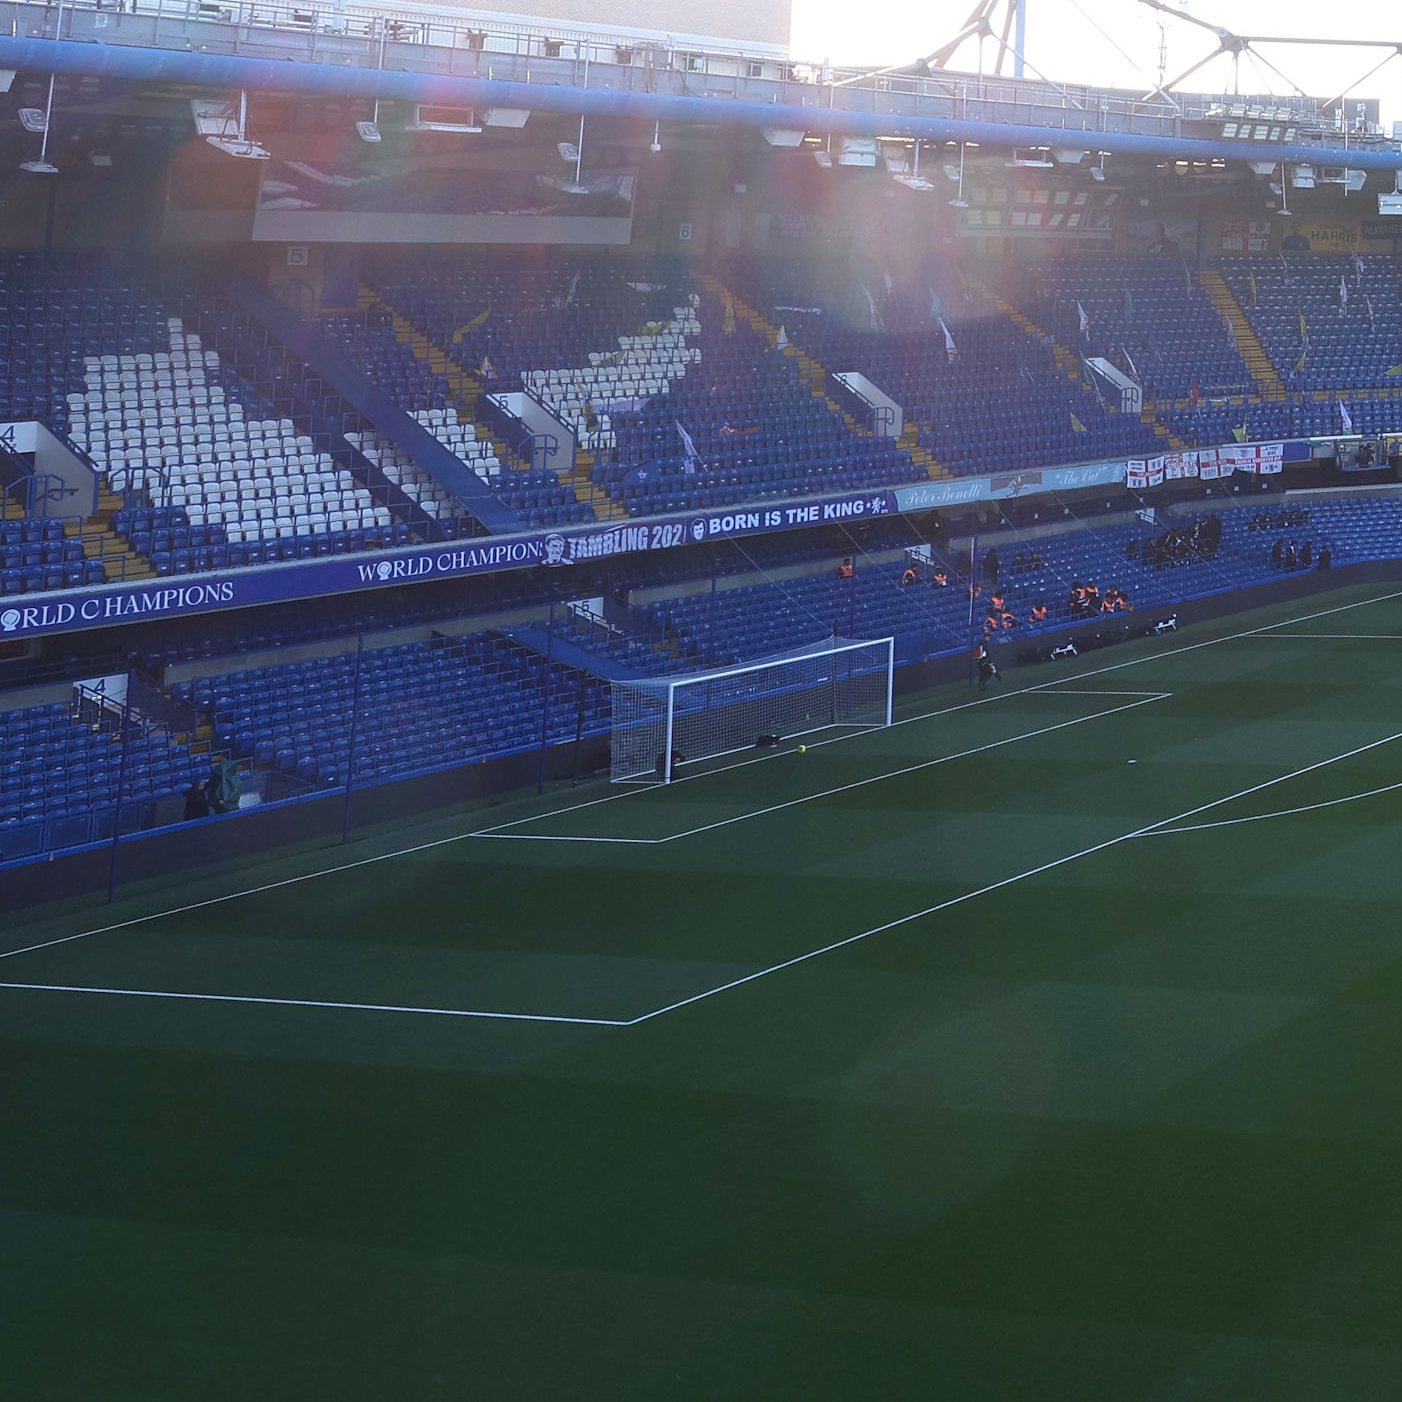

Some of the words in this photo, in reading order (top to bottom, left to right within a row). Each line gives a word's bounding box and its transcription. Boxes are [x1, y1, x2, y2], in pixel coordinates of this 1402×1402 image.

[681, 225, 690, 238] 6
[710, 512, 760, 534] BORN
[765, 508, 782, 525] IS
[786, 508, 820, 524] THE
[824, 500, 865, 519] KING
[568, 528, 648, 559] TAMBLING
[652, 525, 683, 548] 202
[358, 551, 432, 582] WORLD
[0, 601, 76, 632] ORLD
[81, 582, 234, 620] CHAMPIONS
[94, 678, 106, 694] 4
